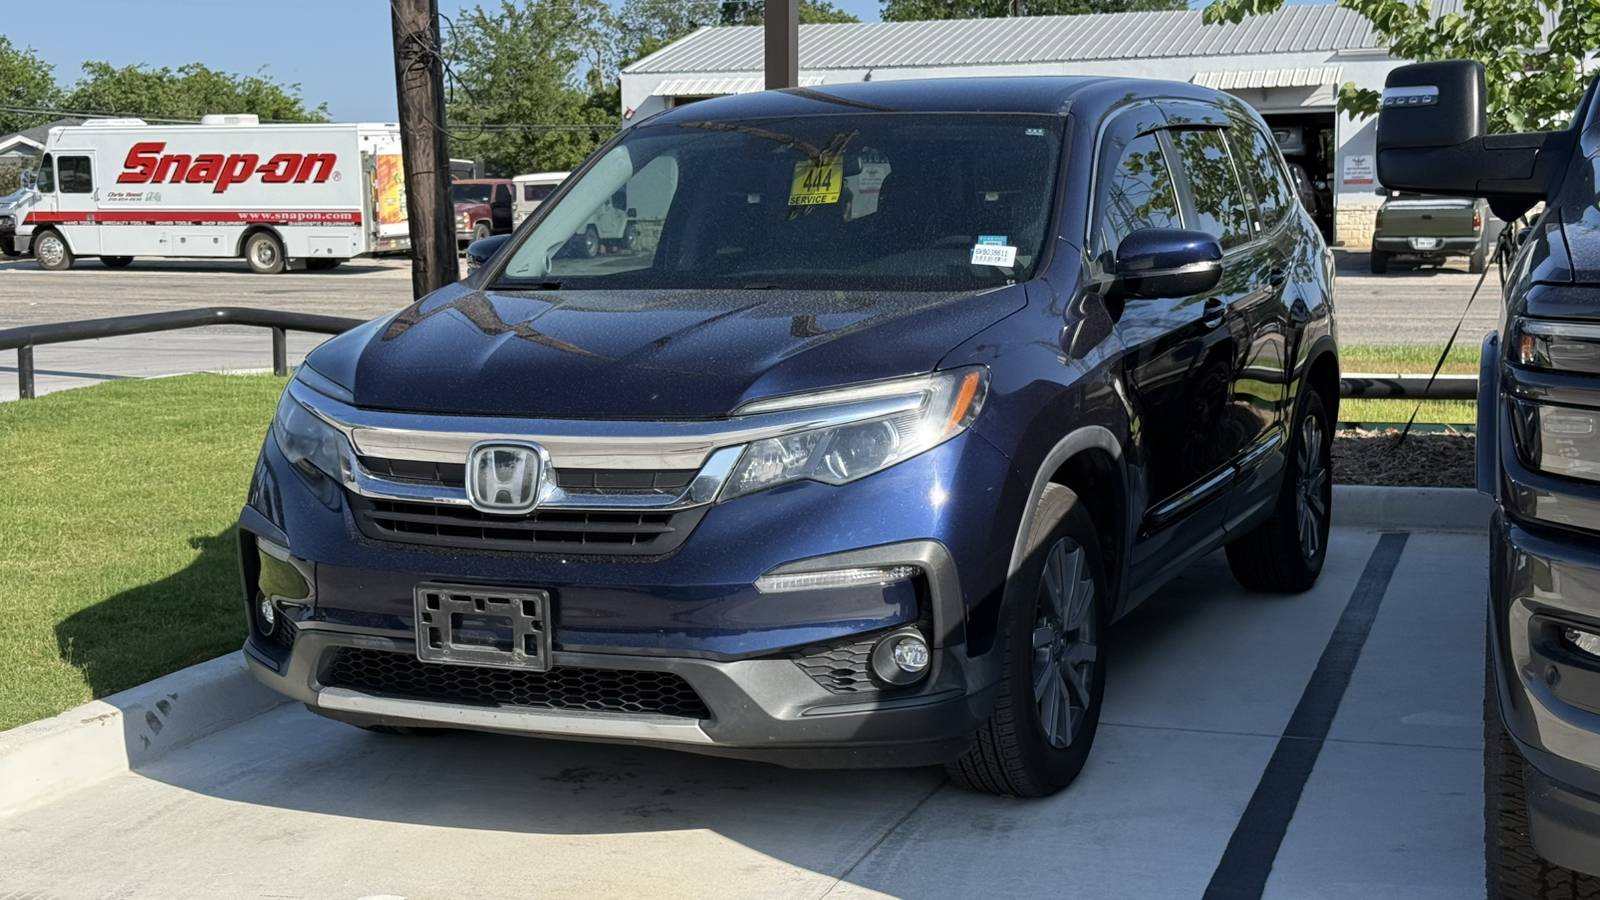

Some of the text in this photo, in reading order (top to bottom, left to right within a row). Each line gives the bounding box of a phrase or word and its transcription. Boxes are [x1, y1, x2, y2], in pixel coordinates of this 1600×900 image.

[116, 142, 337, 194] Snap-on
[803, 169, 832, 192] 444
[790, 195, 828, 205] SERVICE
[237, 212, 352, 221] www.snapon.com
